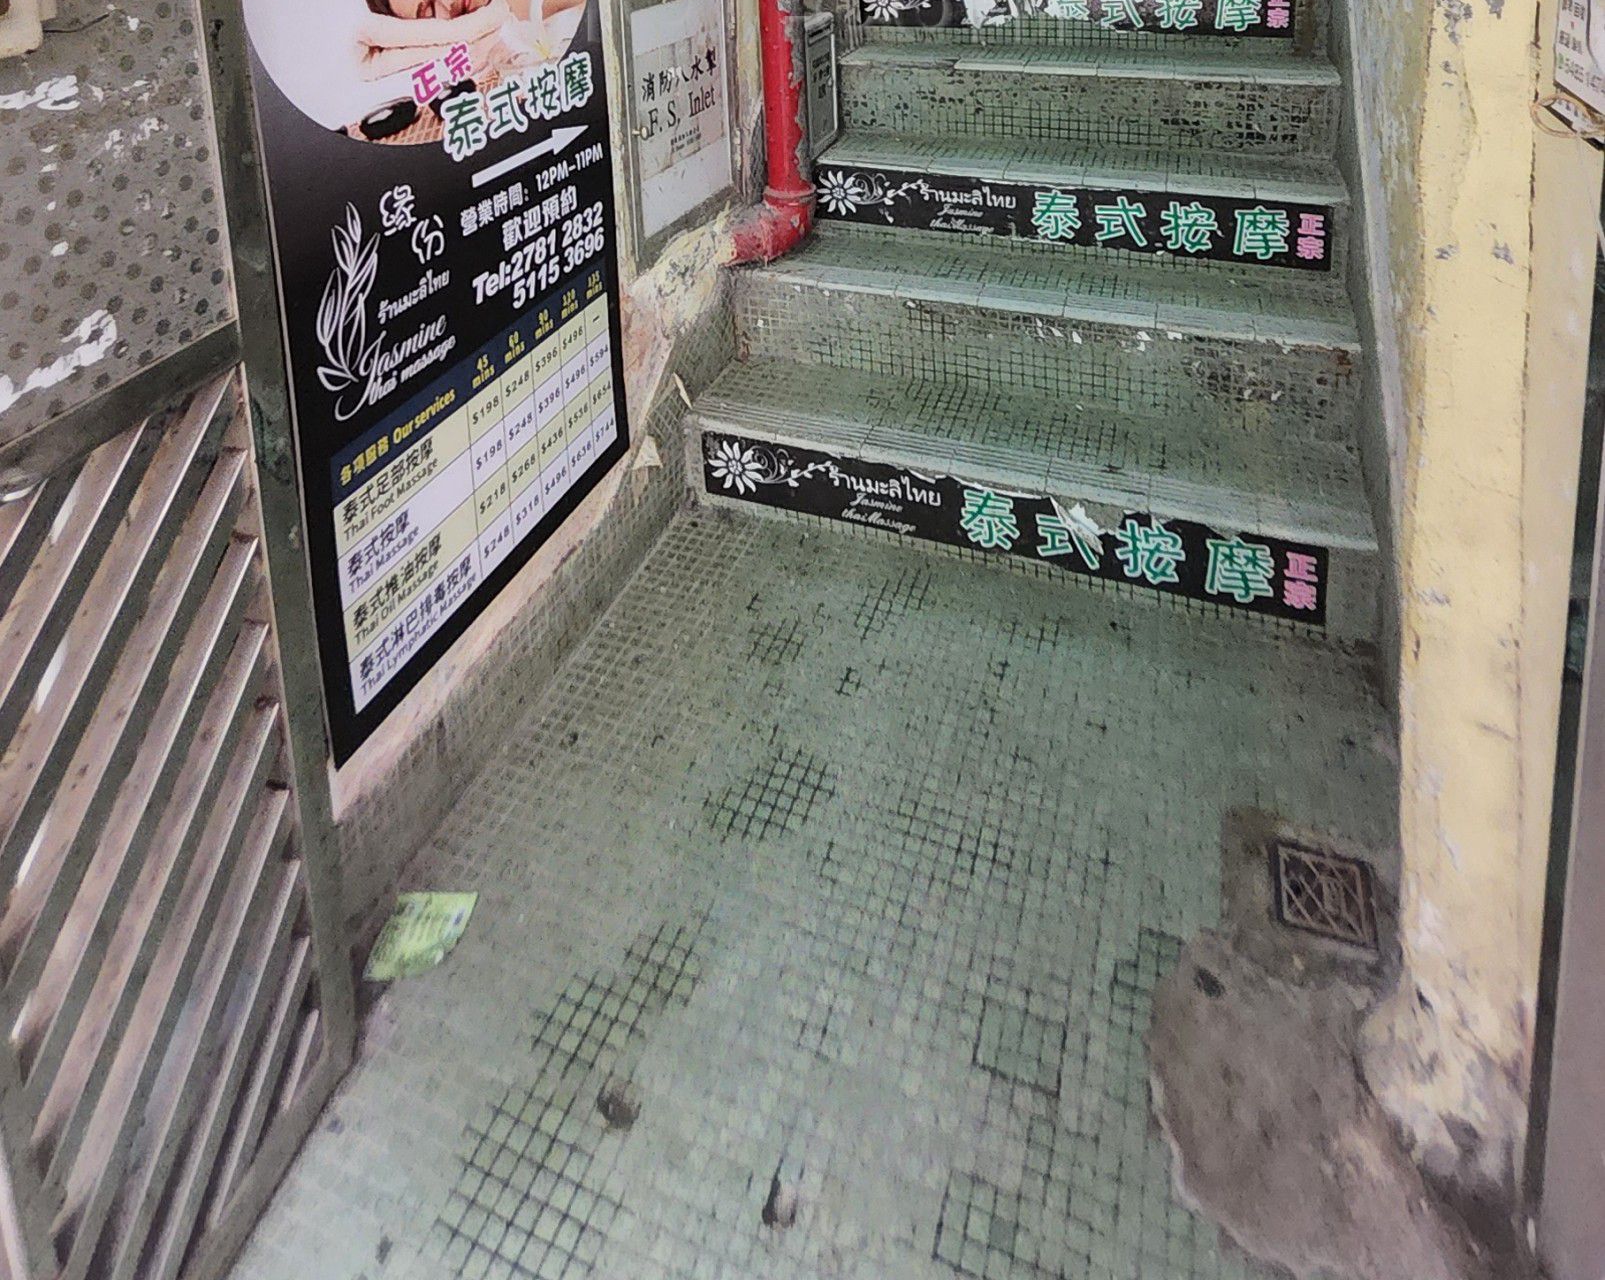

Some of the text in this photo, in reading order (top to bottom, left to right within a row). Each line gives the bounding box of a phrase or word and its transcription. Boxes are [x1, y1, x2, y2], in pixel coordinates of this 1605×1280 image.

[411, 41, 473, 104] 正宗
[440, 51, 595, 162] 泰式按摩
[688, 85, 716, 118] Inlet
[535, 143, 604, 192] 12PM-11PM
[920, 182, 1017, 210] ร้านมะลิไทย
[379, 184, 446, 265] 緣份
[472, 201, 604, 306] Tel:2781 2832
[502, 185, 578, 252] 歡迎預約
[1031, 189, 1290, 260] 泰式按摩
[1296, 212, 1325, 260] 正宗
[377, 268, 450, 324] ร้านมะลิไทย
[512, 227, 605, 310] 5115 3696
[335, 314, 448, 421] Jasmine
[368, 334, 457, 406] thai massage
[343, 435, 433, 526] 泰式足部按摩
[472, 394, 499, 425] $198
[505, 372, 530, 397] $248
[535, 346, 558, 373] $396
[393, 420, 414, 444] Our
[414, 388, 456, 429] services
[343, 456, 438, 542] Thai Foot Massage
[347, 508, 410, 577] 泰式按摩
[475, 439, 503, 470] $198
[508, 411, 533, 441] $248
[538, 387, 561, 414] $396
[827, 466, 943, 508] ร้านมะลิไทย
[850, 490, 904, 513] Jasmine
[349, 524, 420, 594] Thai Massage
[353, 530, 442, 630] 泰式推油按摩
[479, 482, 506, 515] $218
[484, 526, 510, 559] $248
[959, 486, 1276, 604] 泰式按摩
[354, 558, 440, 647] Thai Oil Massage
[1282, 549, 1318, 612] 正宗
[360, 570, 477, 696] Thai Lymphatic Massage
